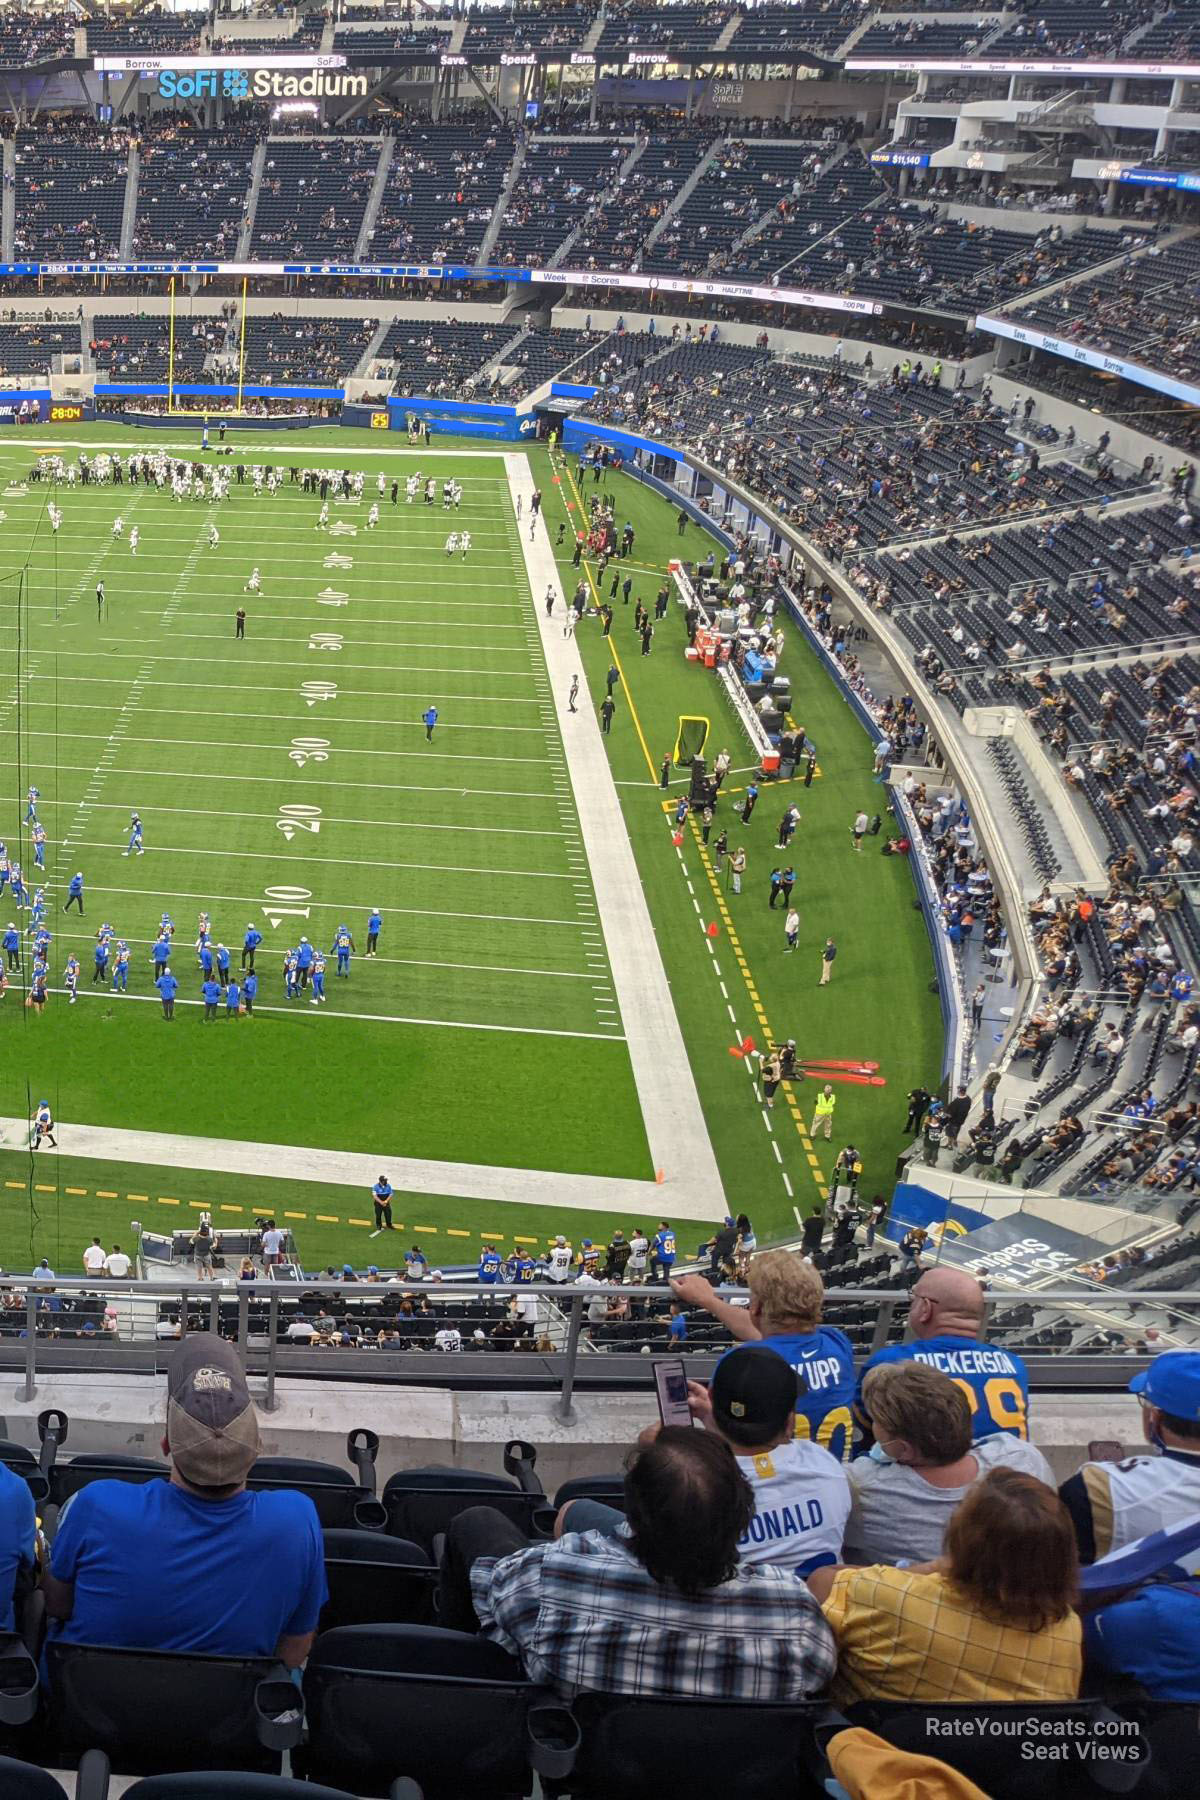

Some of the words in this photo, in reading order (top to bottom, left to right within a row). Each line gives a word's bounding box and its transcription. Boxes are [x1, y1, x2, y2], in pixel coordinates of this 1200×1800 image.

[125, 59, 163, 68] Borrow.
[316, 57, 337, 66] SoF
[440, 55, 468, 65] Save.
[500, 54, 537, 66] Spend.
[570, 54, 596, 64] Earn.
[628, 53, 669, 64] Borrow.
[159, 71, 217, 98] SoFi
[253, 70, 367, 97] Stadium
[892, 155, 921, 165] $11,140
[543, 273, 567, 282] Week
[591, 275, 620, 285] Scores
[706, 284, 714, 292] 10
[722, 286, 753, 295] HALFTIME
[1013, 329, 1027, 341] Save.
[1042, 338, 1059, 350] Spend.
[1074, 348, 1088, 360] Earn.
[1103, 359, 1125, 373] Borrow.
[51, 407, 81, 419] 28:04
[373, 414, 388, 429] 25
[316, 591, 349, 607] 40
[308, 632, 344, 651] 50
[299, 681, 338, 701] 40
[288, 737, 331, 762] 30
[276, 804, 322, 833] 20
[261, 885, 312, 919] 10
[444, 1340, 459, 1352] 32
[914, 1350, 1017, 1375] DICKERSON
[193, 1374, 232, 1392] RAMS
